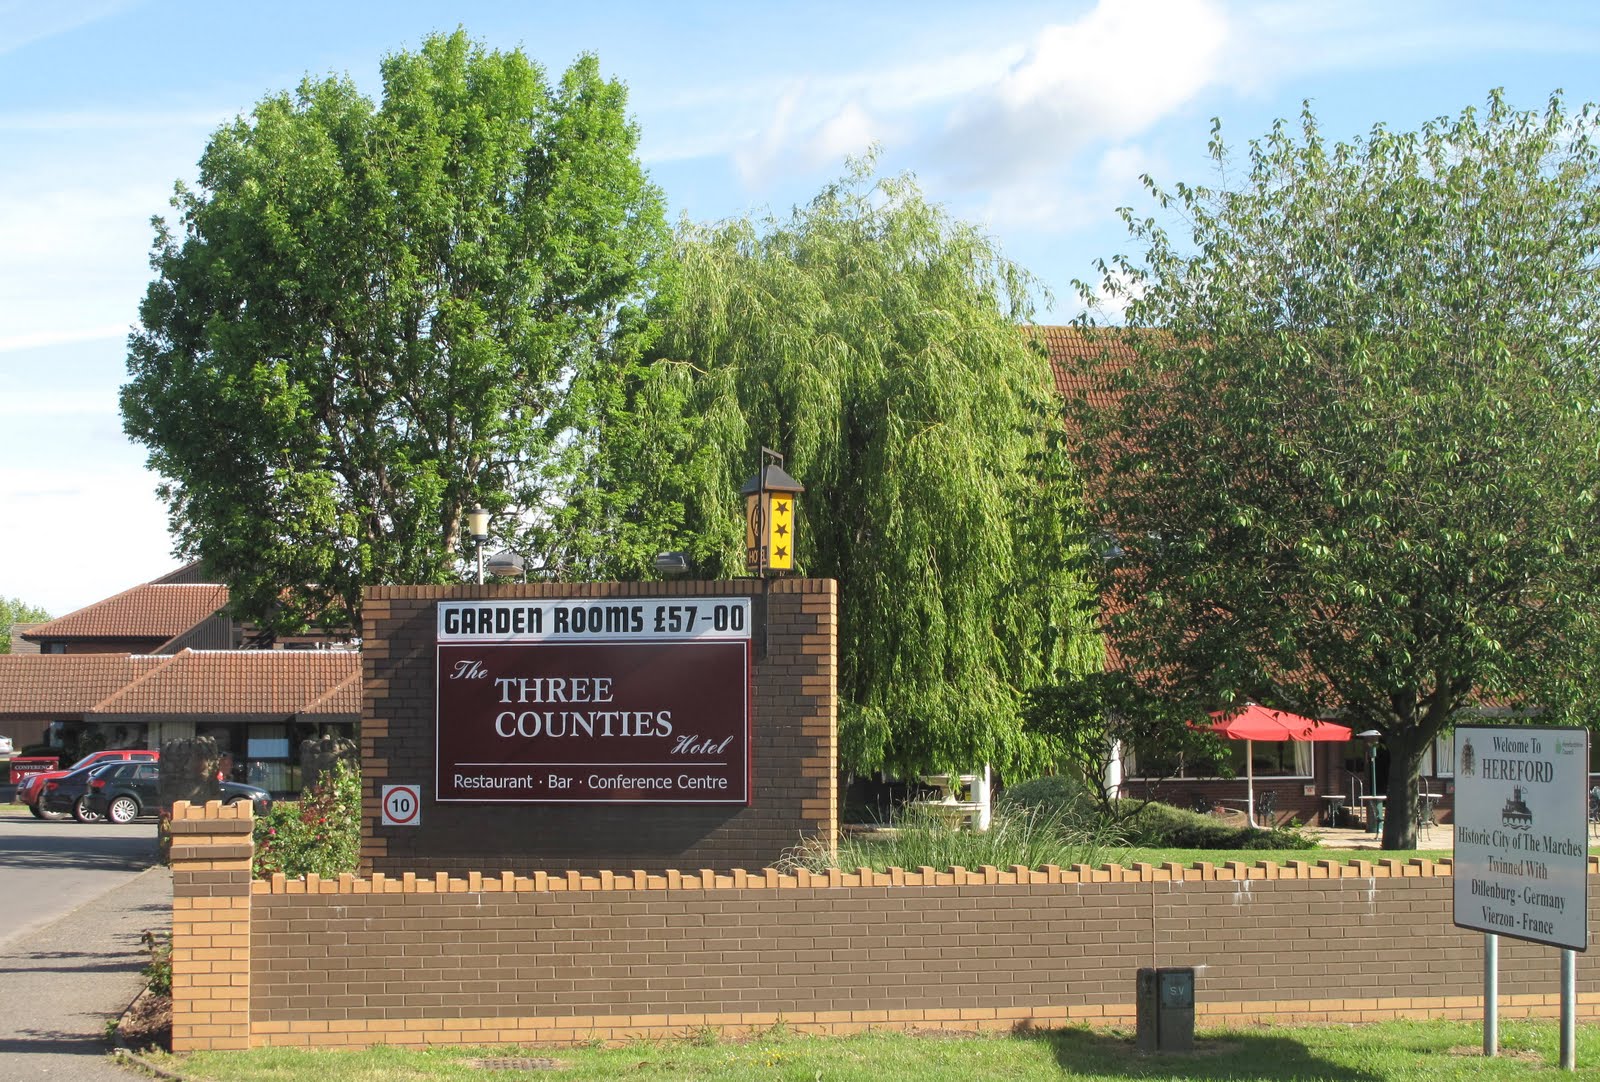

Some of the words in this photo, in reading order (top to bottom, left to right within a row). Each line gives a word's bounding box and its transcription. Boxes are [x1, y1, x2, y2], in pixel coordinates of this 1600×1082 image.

[748, 549, 768, 564] HOEL
[444, 607, 543, 634] GARDEN
[554, 606, 644, 633] ROOMS
[450, 660, 488, 680] The
[494, 677, 614, 703] THREE
[495, 710, 673, 738] COUNTIES
[670, 734, 734, 755] Hotel
[1493, 736, 1529, 754] Welcome
[1531, 738, 1541, 754] To
[454, 774, 533, 789] Restaurant
[548, 774, 573, 789] Bar
[588, 774, 672, 789] Conference
[677, 774, 728, 789] Centre
[1482, 758, 1553, 783] HEREFORD
[392, 798, 410, 812] 10
[1458, 826, 1490, 846] Historic
[1492, 829, 1511, 853] City
[1512, 832, 1522, 850] of
[1524, 833, 1540, 852] The
[1543, 835, 1582, 857] Marches
[1487, 855, 1523, 876] Twinned
[1526, 860, 1548, 880] With
[1471, 878, 1516, 906] Dillenburg
[1523, 886, 1566, 915] Germany
[1482, 905, 1514, 928] Vierzon
[1522, 912, 1554, 935] France
